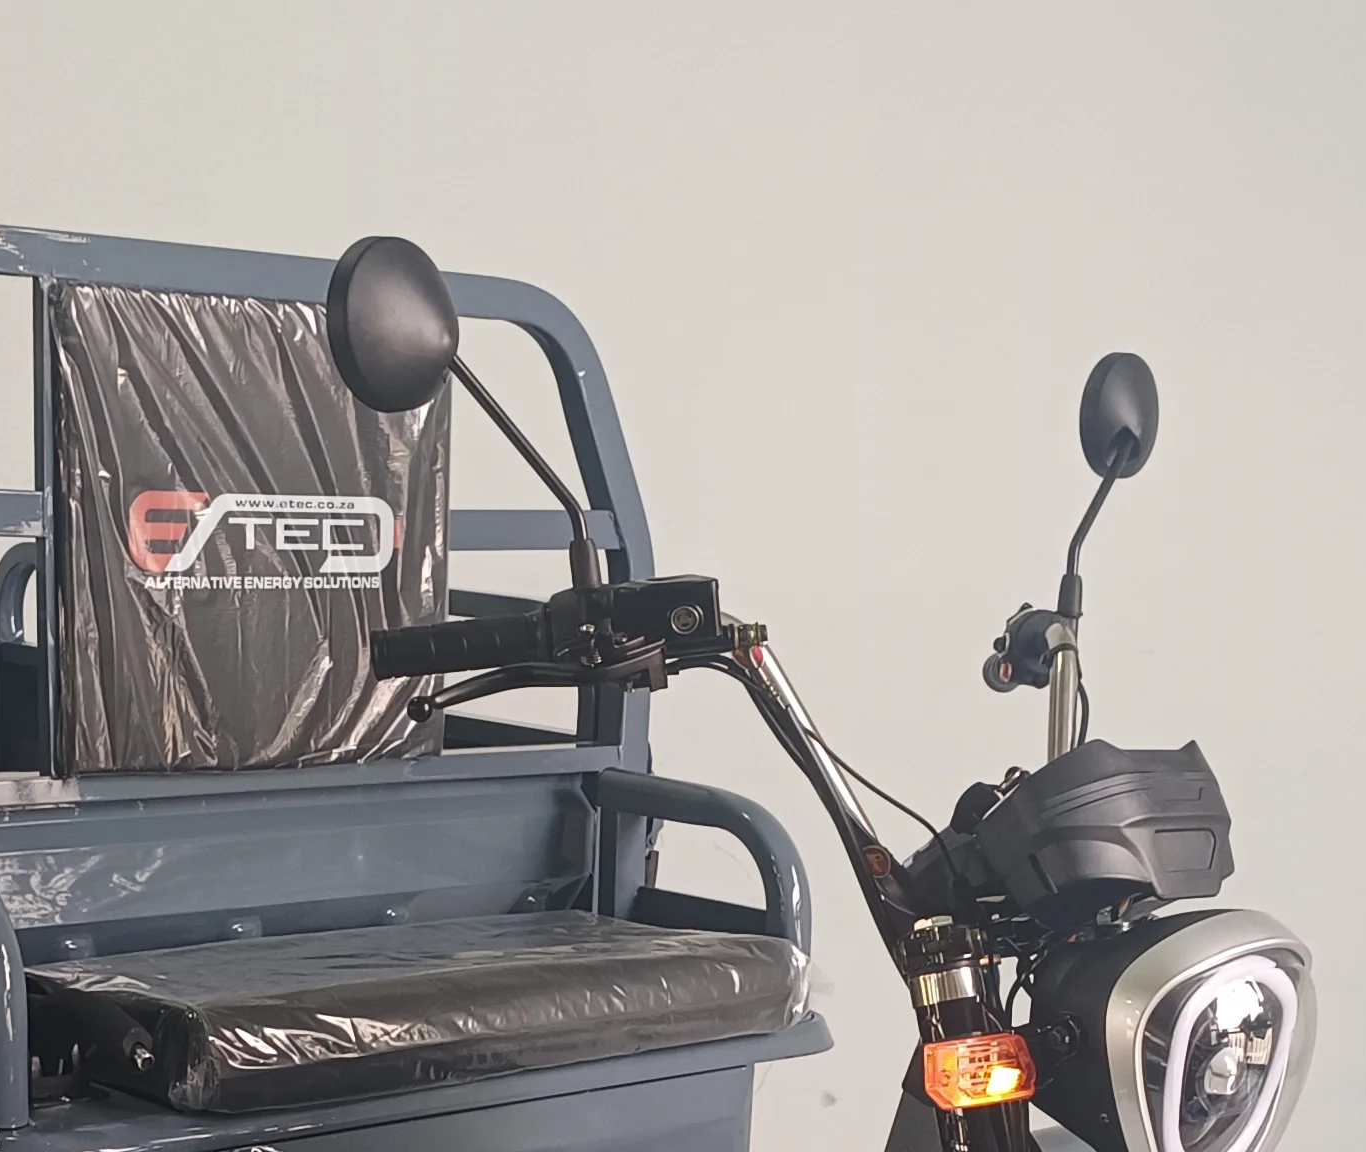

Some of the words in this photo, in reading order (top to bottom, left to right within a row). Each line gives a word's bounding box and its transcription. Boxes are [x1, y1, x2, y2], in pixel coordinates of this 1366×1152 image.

[235, 499, 355, 510] www.etec.co.za
[144, 576, 242, 590] ALTERNATIVE
[244, 576, 302, 590] ENERGY
[303, 576, 380, 590] SOLUTIONS
